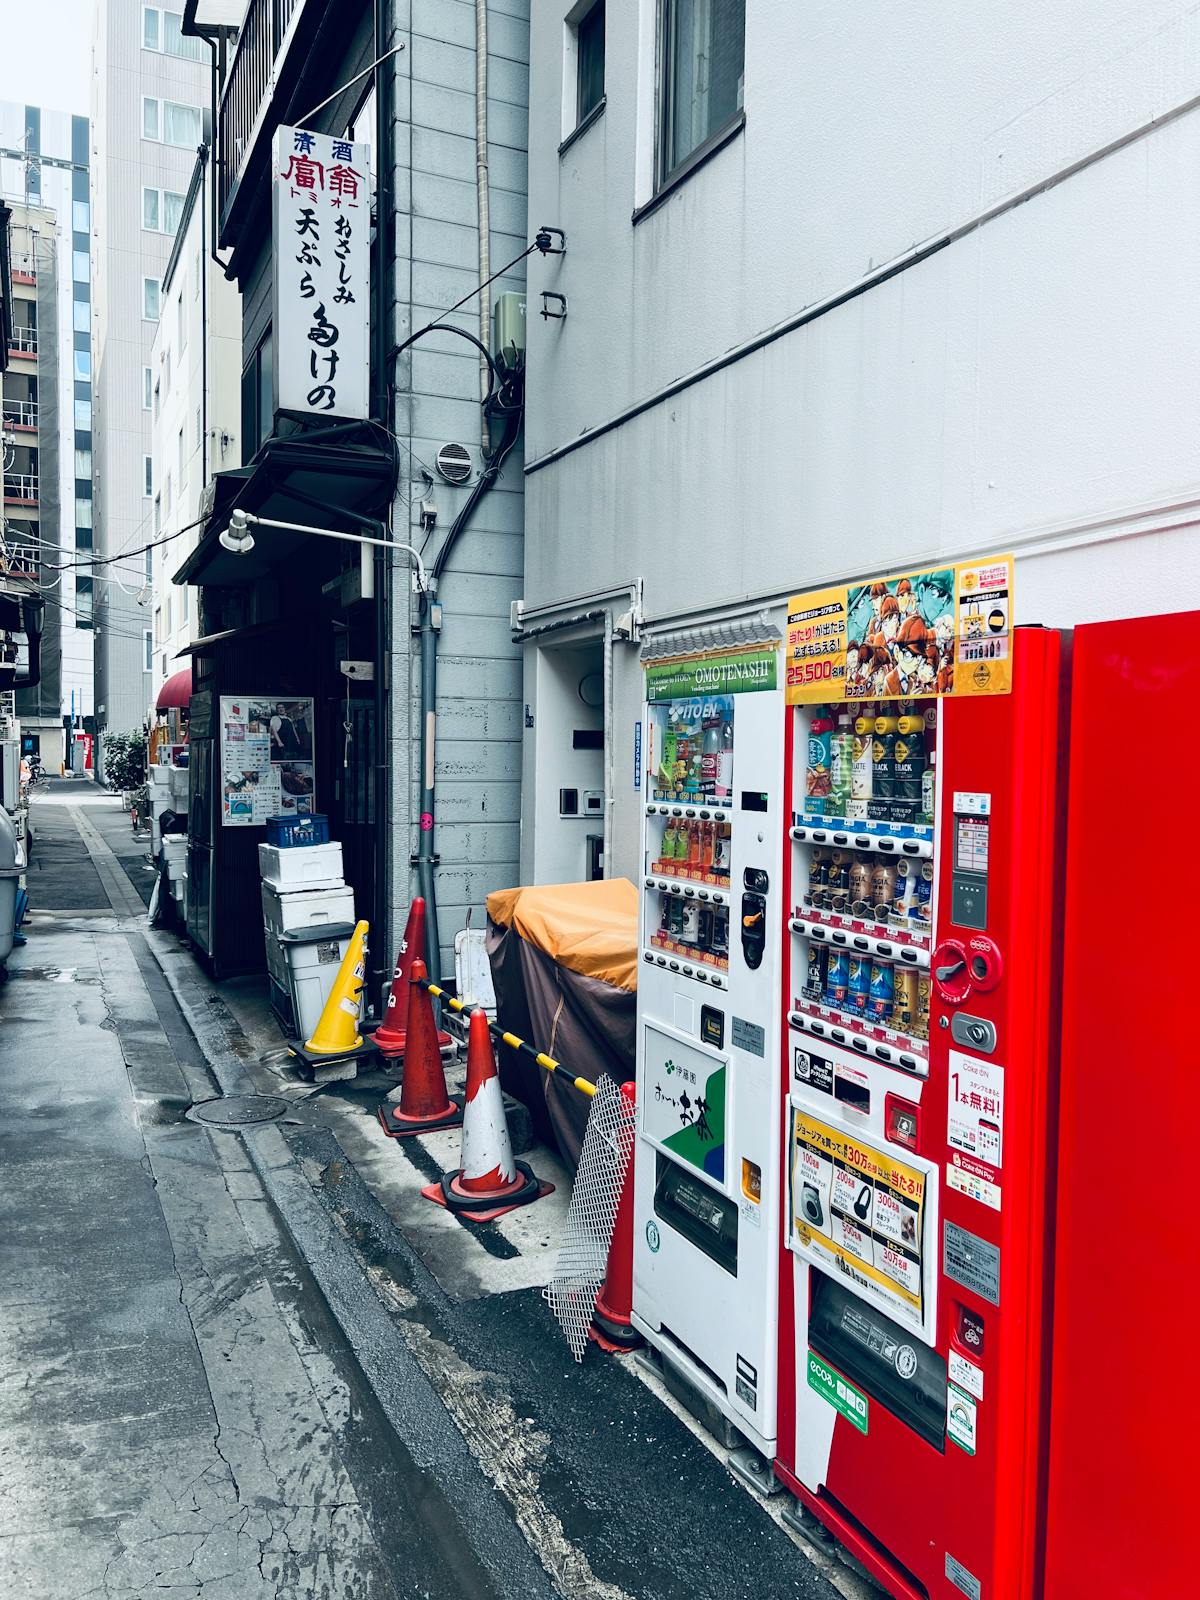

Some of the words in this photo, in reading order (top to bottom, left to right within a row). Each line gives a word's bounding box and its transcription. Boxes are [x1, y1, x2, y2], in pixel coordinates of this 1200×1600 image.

[280, 154, 365, 199] 富翁
[293, 132, 353, 162] 清酒
[294, 208, 321, 298] 天ぷら
[332, 214, 356, 305] おさしみ
